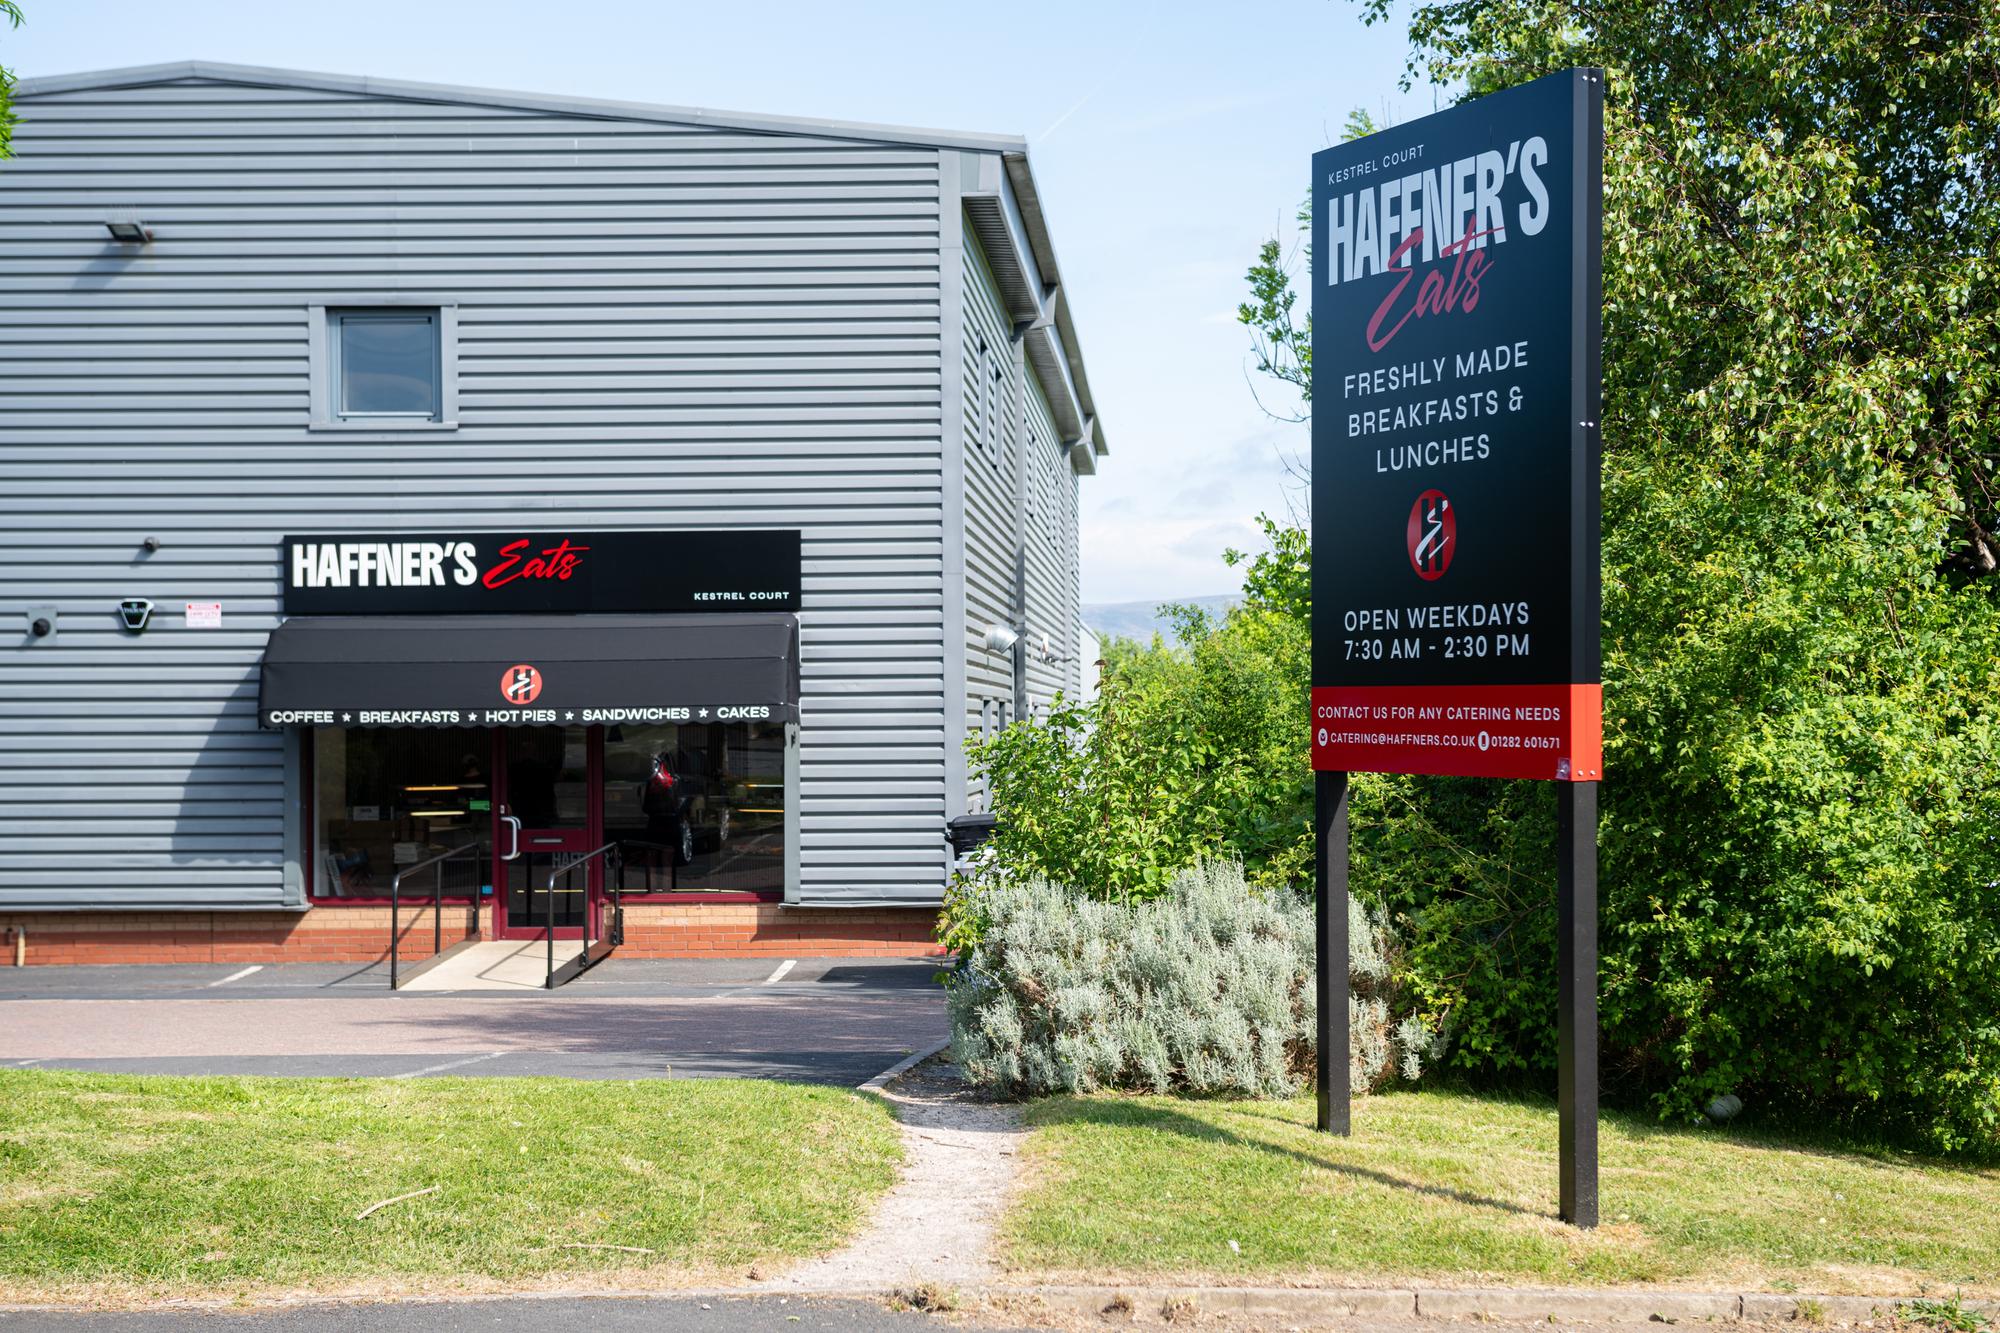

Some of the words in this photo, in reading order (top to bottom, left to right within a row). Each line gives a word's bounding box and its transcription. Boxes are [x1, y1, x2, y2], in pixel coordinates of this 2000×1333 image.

[1328, 161, 1378, 185] KESTREL
[1383, 145, 1424, 169] COURT
[1328, 136, 1549, 286] HAFFNER'S
[1366, 214, 1504, 352] Eats
[1344, 357, 1446, 398] FRESHLY
[1456, 340, 1528, 378] MADE
[1348, 390, 1498, 437] BREAKFASTS
[1508, 385, 1523, 411] &
[1377, 434, 1490, 473] LUNCHES
[292, 542, 477, 588] HAFFNER'S
[482, 539, 591, 590] Eats
[694, 592, 745, 601] KESTREL
[749, 591, 790, 600] COURT
[1344, 609, 1399, 632] OPEN
[1407, 602, 1529, 629] WEEKDAYS
[1344, 638, 1383, 660] 7:30
[1390, 638, 1420, 659] AM
[1444, 636, 1487, 659] 2:30
[1496, 634, 1529, 656] PM
[270, 711, 334, 723] COFFEE
[359, 711, 460, 723] BREAKFASTS
[485, 710, 519, 722] HOT
[522, 710, 557, 722] PIES
[582, 708, 690, 722] SANDWICHES
[717, 707, 770, 719] CAKES
[1318, 706, 1369, 719] CONTACT
[1373, 707, 1387, 719] US
[1391, 707, 1415, 720] FOR
[1418, 707, 1442, 720] ANY
[1446, 707, 1511, 721] CATERING
[1515, 708, 1561, 721] NEEDS
[1330, 732, 1475, 748] CATERING@HAFFNERS.CO.UK
[1491, 735, 1521, 748] 01282
[1524, 736, 1560, 749] 601671
